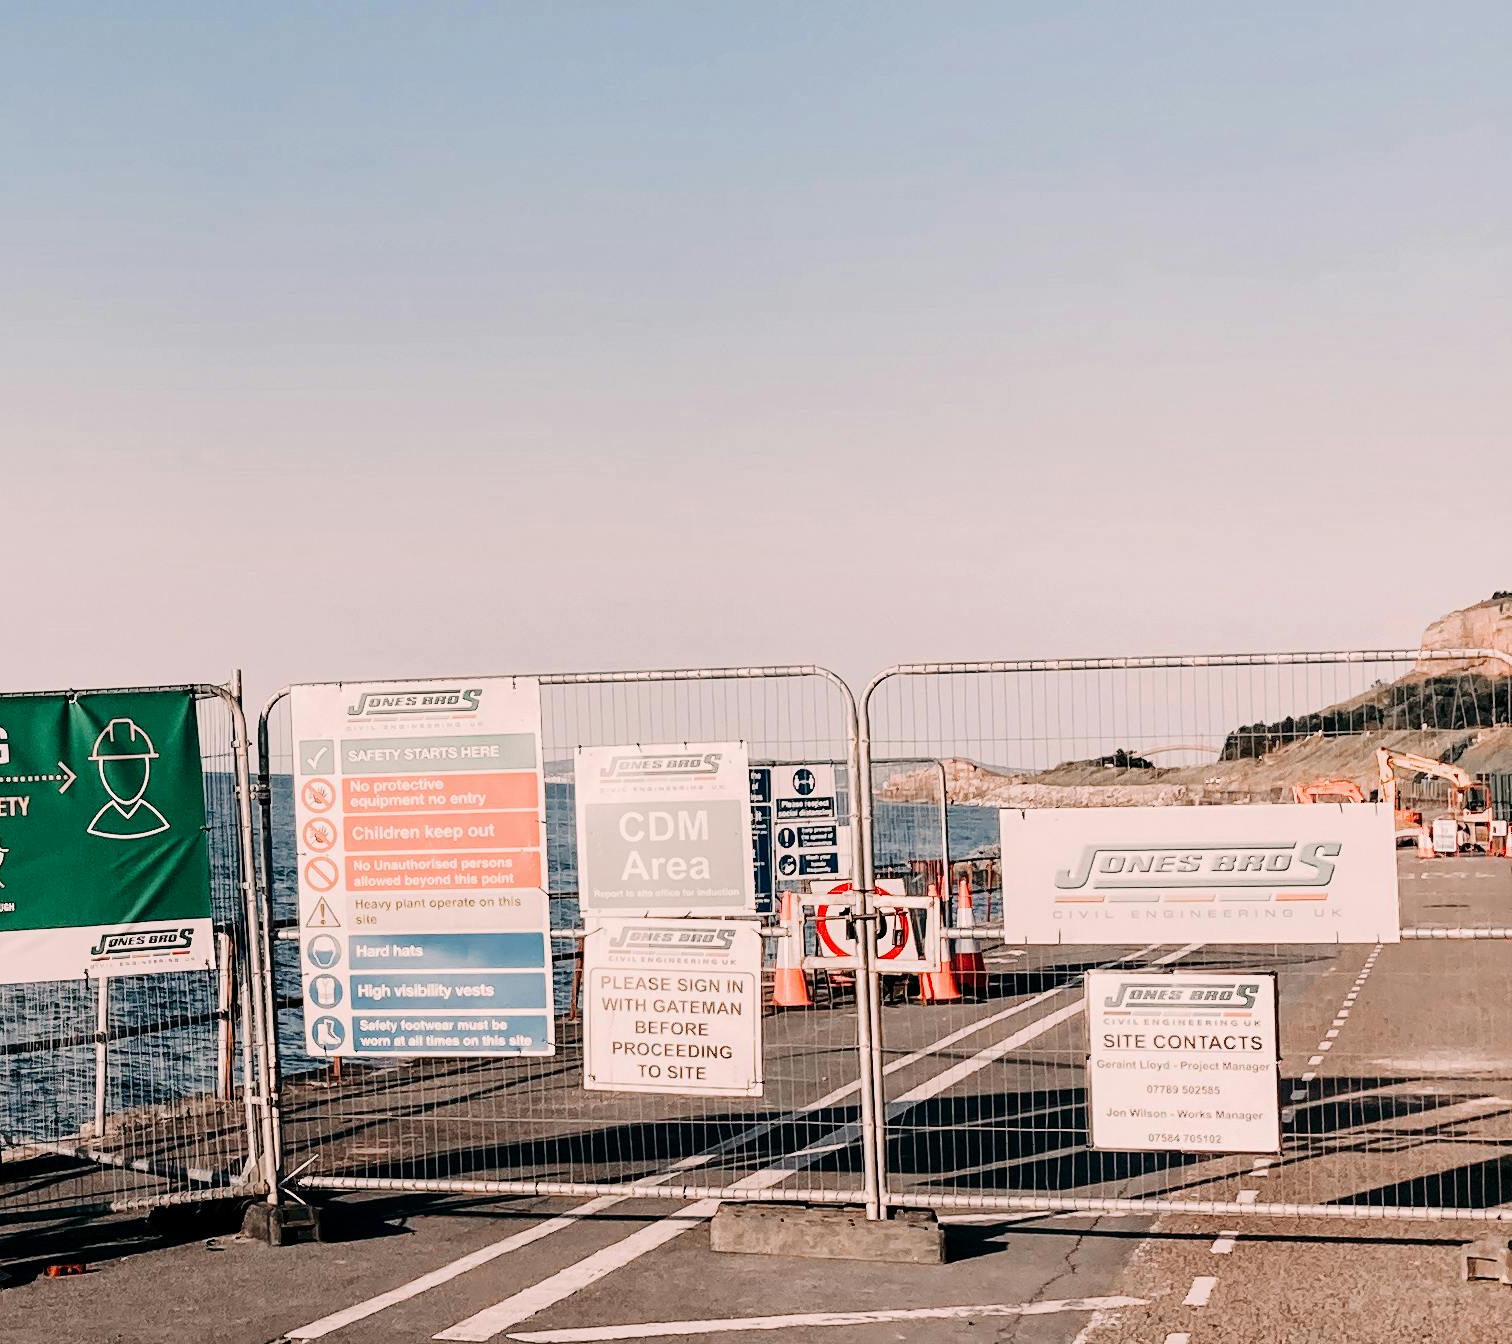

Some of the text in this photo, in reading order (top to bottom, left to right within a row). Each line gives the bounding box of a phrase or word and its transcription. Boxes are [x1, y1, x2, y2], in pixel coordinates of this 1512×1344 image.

[347, 689, 483, 716] JONES BROS
[348, 746, 500, 762] SAFETY STARTS HERE
[600, 756, 663, 778] JONES
[350, 779, 444, 794] No protective
[350, 793, 486, 808] equipment no entry
[352, 824, 495, 840] Children keep out
[619, 810, 709, 842] CDM
[353, 858, 513, 871] No Unauthorised persons
[621, 850, 711, 881] Area
[1054, 842, 1343, 890] JONES BROS
[353, 872, 514, 888] allowed beyond this point
[355, 896, 521, 911] Heavy plant operate on this
[356, 914, 377, 925] site
[1052, 908, 1344, 919] CIVIL ENGINEERING UK
[91, 928, 194, 955] JONES BROS
[609, 927, 736, 950] JONES BROS
[356, 944, 424, 957] Hard hats
[640, 957, 718, 965] ENGINEERING
[357, 984, 495, 999] High visibility vests
[601, 976, 744, 994] PLEASE SIGN IN
[1104, 983, 1260, 1009] JONES BROS
[602, 998, 742, 1015] WITH GATEMAN
[360, 1019, 508, 1033] Safety footwear must be
[635, 1020, 709, 1036] BEFORE
[1144, 1018, 1238, 1026] ENGINEERING
[360, 1035, 532, 1047] worn at all times on this site
[1104, 1034, 1263, 1050] SITE CONTACTS
[612, 1042, 733, 1059] PROCEEDING
[638, 1064, 707, 1080] TO SITE
[1097, 1059, 1136, 1070] Geraint
[1139, 1060, 1170, 1072] Lloyd
[1180, 1061, 1219, 1073] Project
[1223, 1062, 1270, 1073] Manager
[1106, 1108, 1127, 1118] Jon
[1130, 1108, 1167, 1118] Wilson
[1178, 1109, 1212, 1119] Works
[1215, 1110, 1264, 1122] Manager
